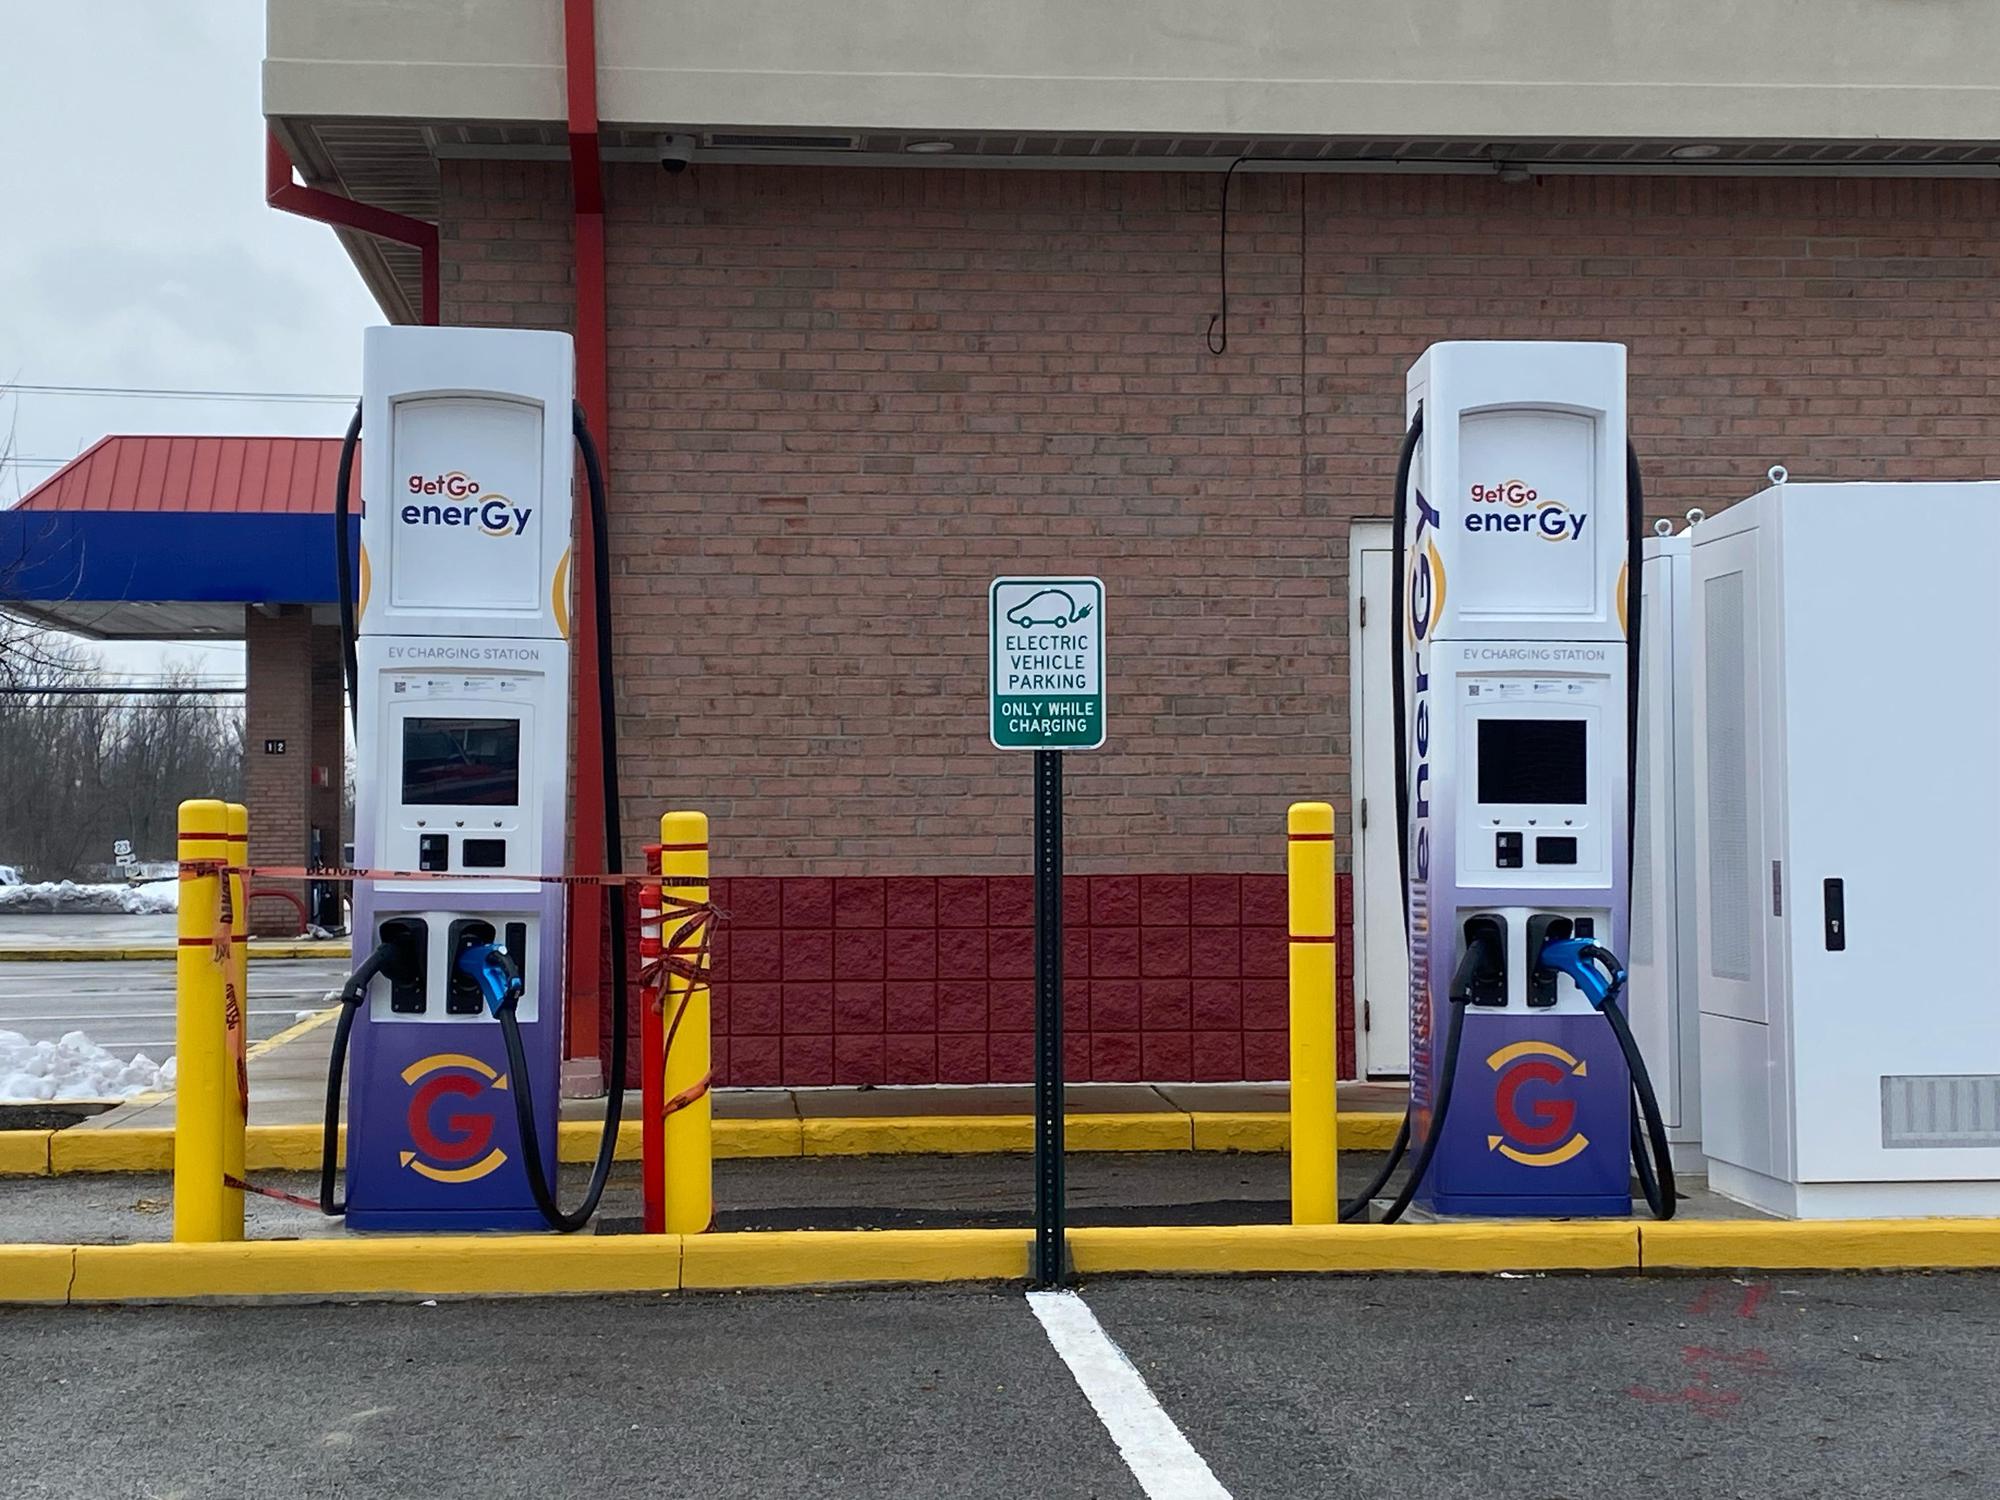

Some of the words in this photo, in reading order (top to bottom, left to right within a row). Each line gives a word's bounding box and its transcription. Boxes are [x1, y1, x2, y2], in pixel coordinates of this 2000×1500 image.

[408, 475, 480, 496] getGo
[1471, 484, 1537, 503] getGo
[401, 500, 532, 535] enerGy
[1465, 507, 1587, 540] enerGy
[1006, 635, 1088, 651] ELECTRIC
[388, 647, 404, 658] EV
[407, 647, 480, 660] CHARGING
[484, 648, 539, 660] STATION
[1463, 648, 1479, 660] EV
[1481, 649, 1550, 660] CHARGING
[1553, 649, 1605, 661] STATION
[1011, 655, 1085, 670] VEHICLE
[1009, 674, 1086, 690] PARKING
[1001, 702, 1042, 716] ONLY
[1048, 702, 1094, 716] WHILE
[1009, 719, 1087, 733] CHARGING
[116, 842, 129, 853] 23
[1495, 1061, 1577, 1146] G
[408, 1074, 495, 1162] G
